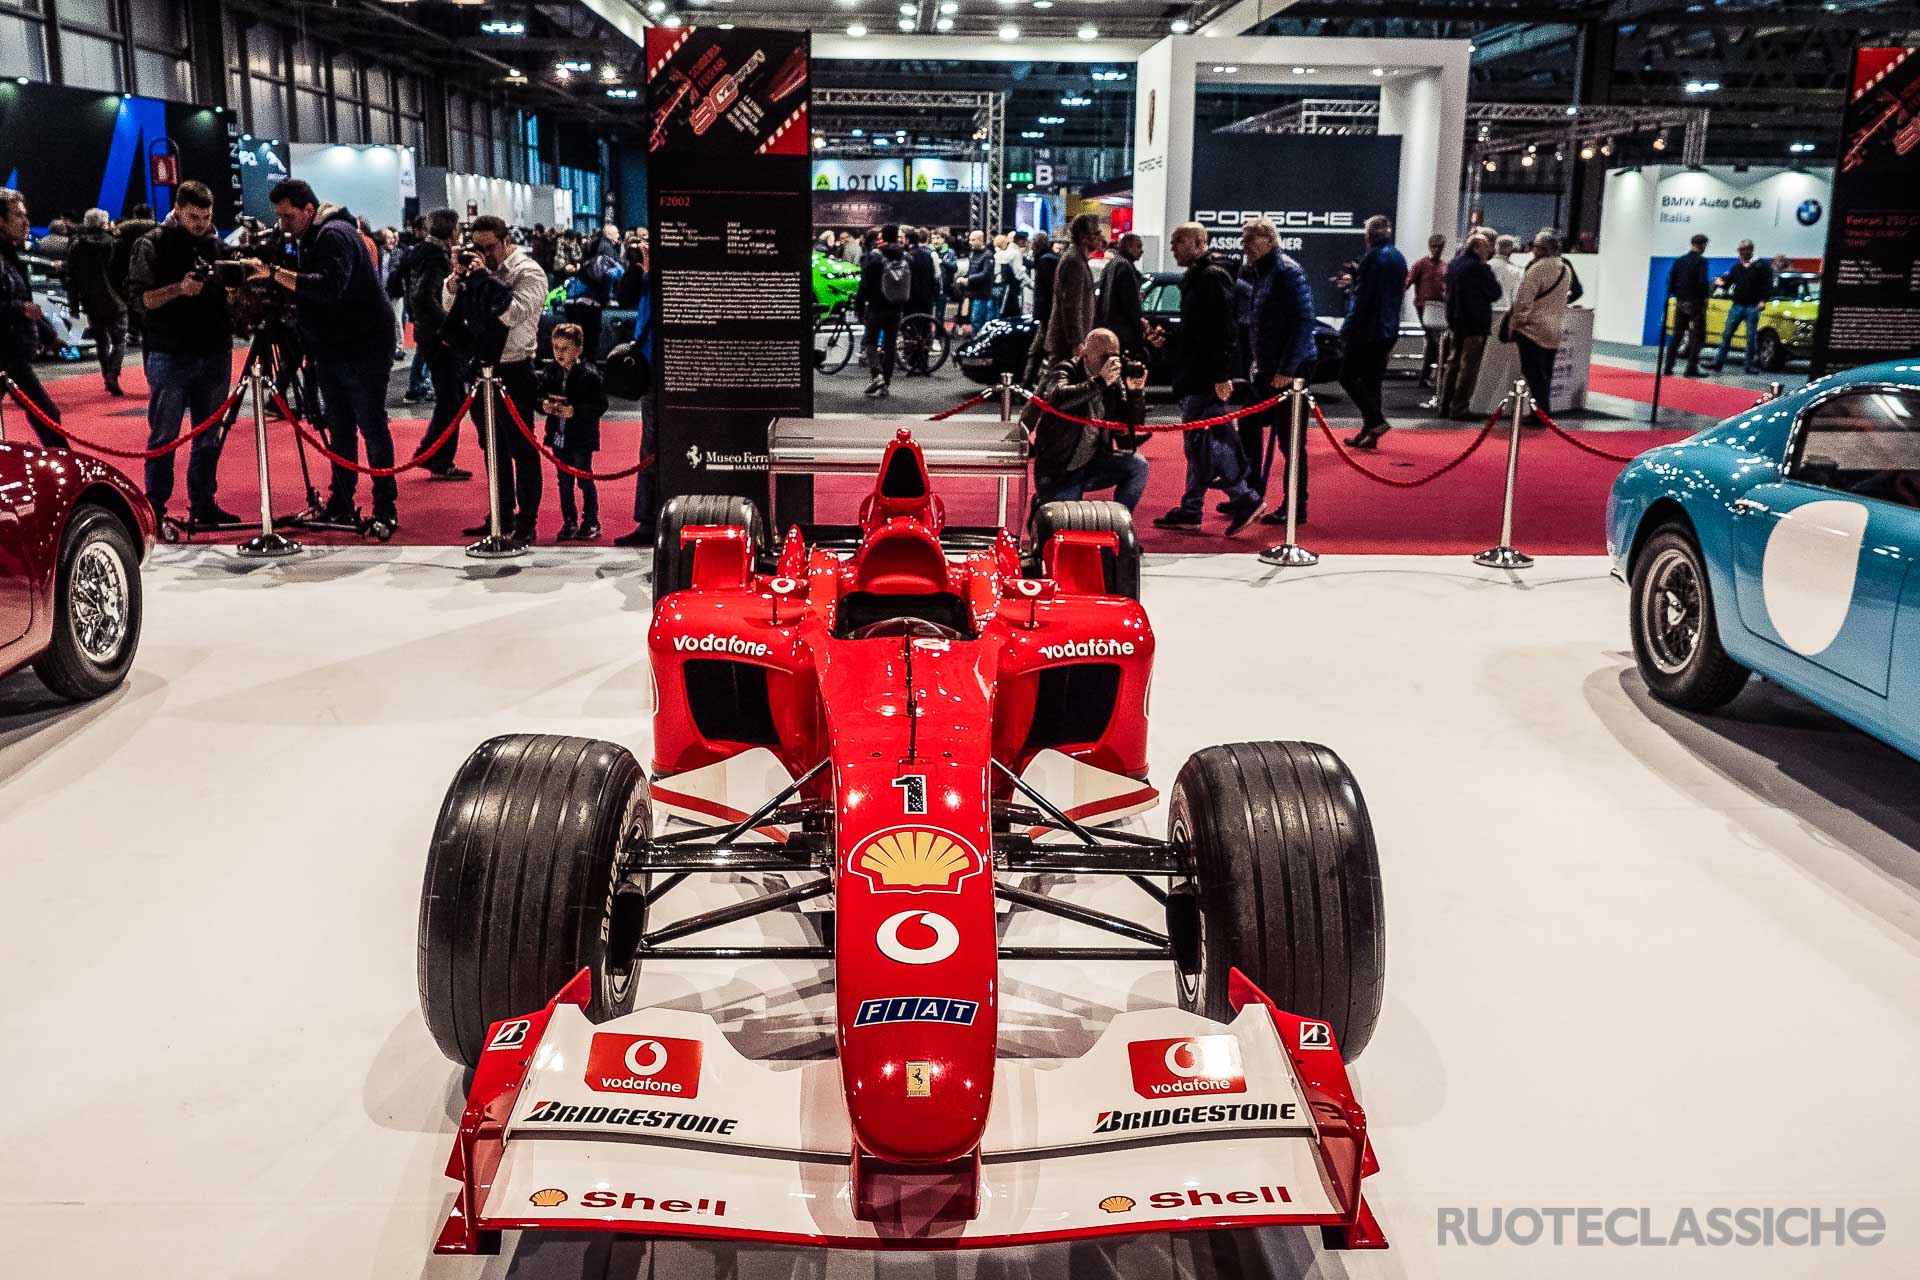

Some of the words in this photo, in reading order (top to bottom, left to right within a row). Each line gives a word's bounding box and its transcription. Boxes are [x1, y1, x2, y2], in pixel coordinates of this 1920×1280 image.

[837, 174, 898, 190] LOTUS
[1035, 165, 1053, 185] B
[660, 196, 690, 206] F2002
[1662, 196, 1695, 207] BMW
[1699, 197, 1730, 208] Auto
[1732, 197, 1762, 209] Club
[1660, 212, 1691, 223] Italia
[1208, 236, 1245, 250] ASSIC
[706, 451, 741, 463] Museo
[673, 633, 767, 656] vodafone
[1041, 638, 1134, 659] vodafone
[891, 774, 927, 814] 1
[865, 1001, 970, 1021] FIAT
[601, 1075, 682, 1093] vodafone
[1151, 1078, 1231, 1095] vodafone
[523, 1101, 738, 1136] BRIDGESTONE
[1093, 1103, 1296, 1134] BRIDGESTONE
[580, 1191, 726, 1217] Shell
[1149, 1186, 1292, 1209] Shell
